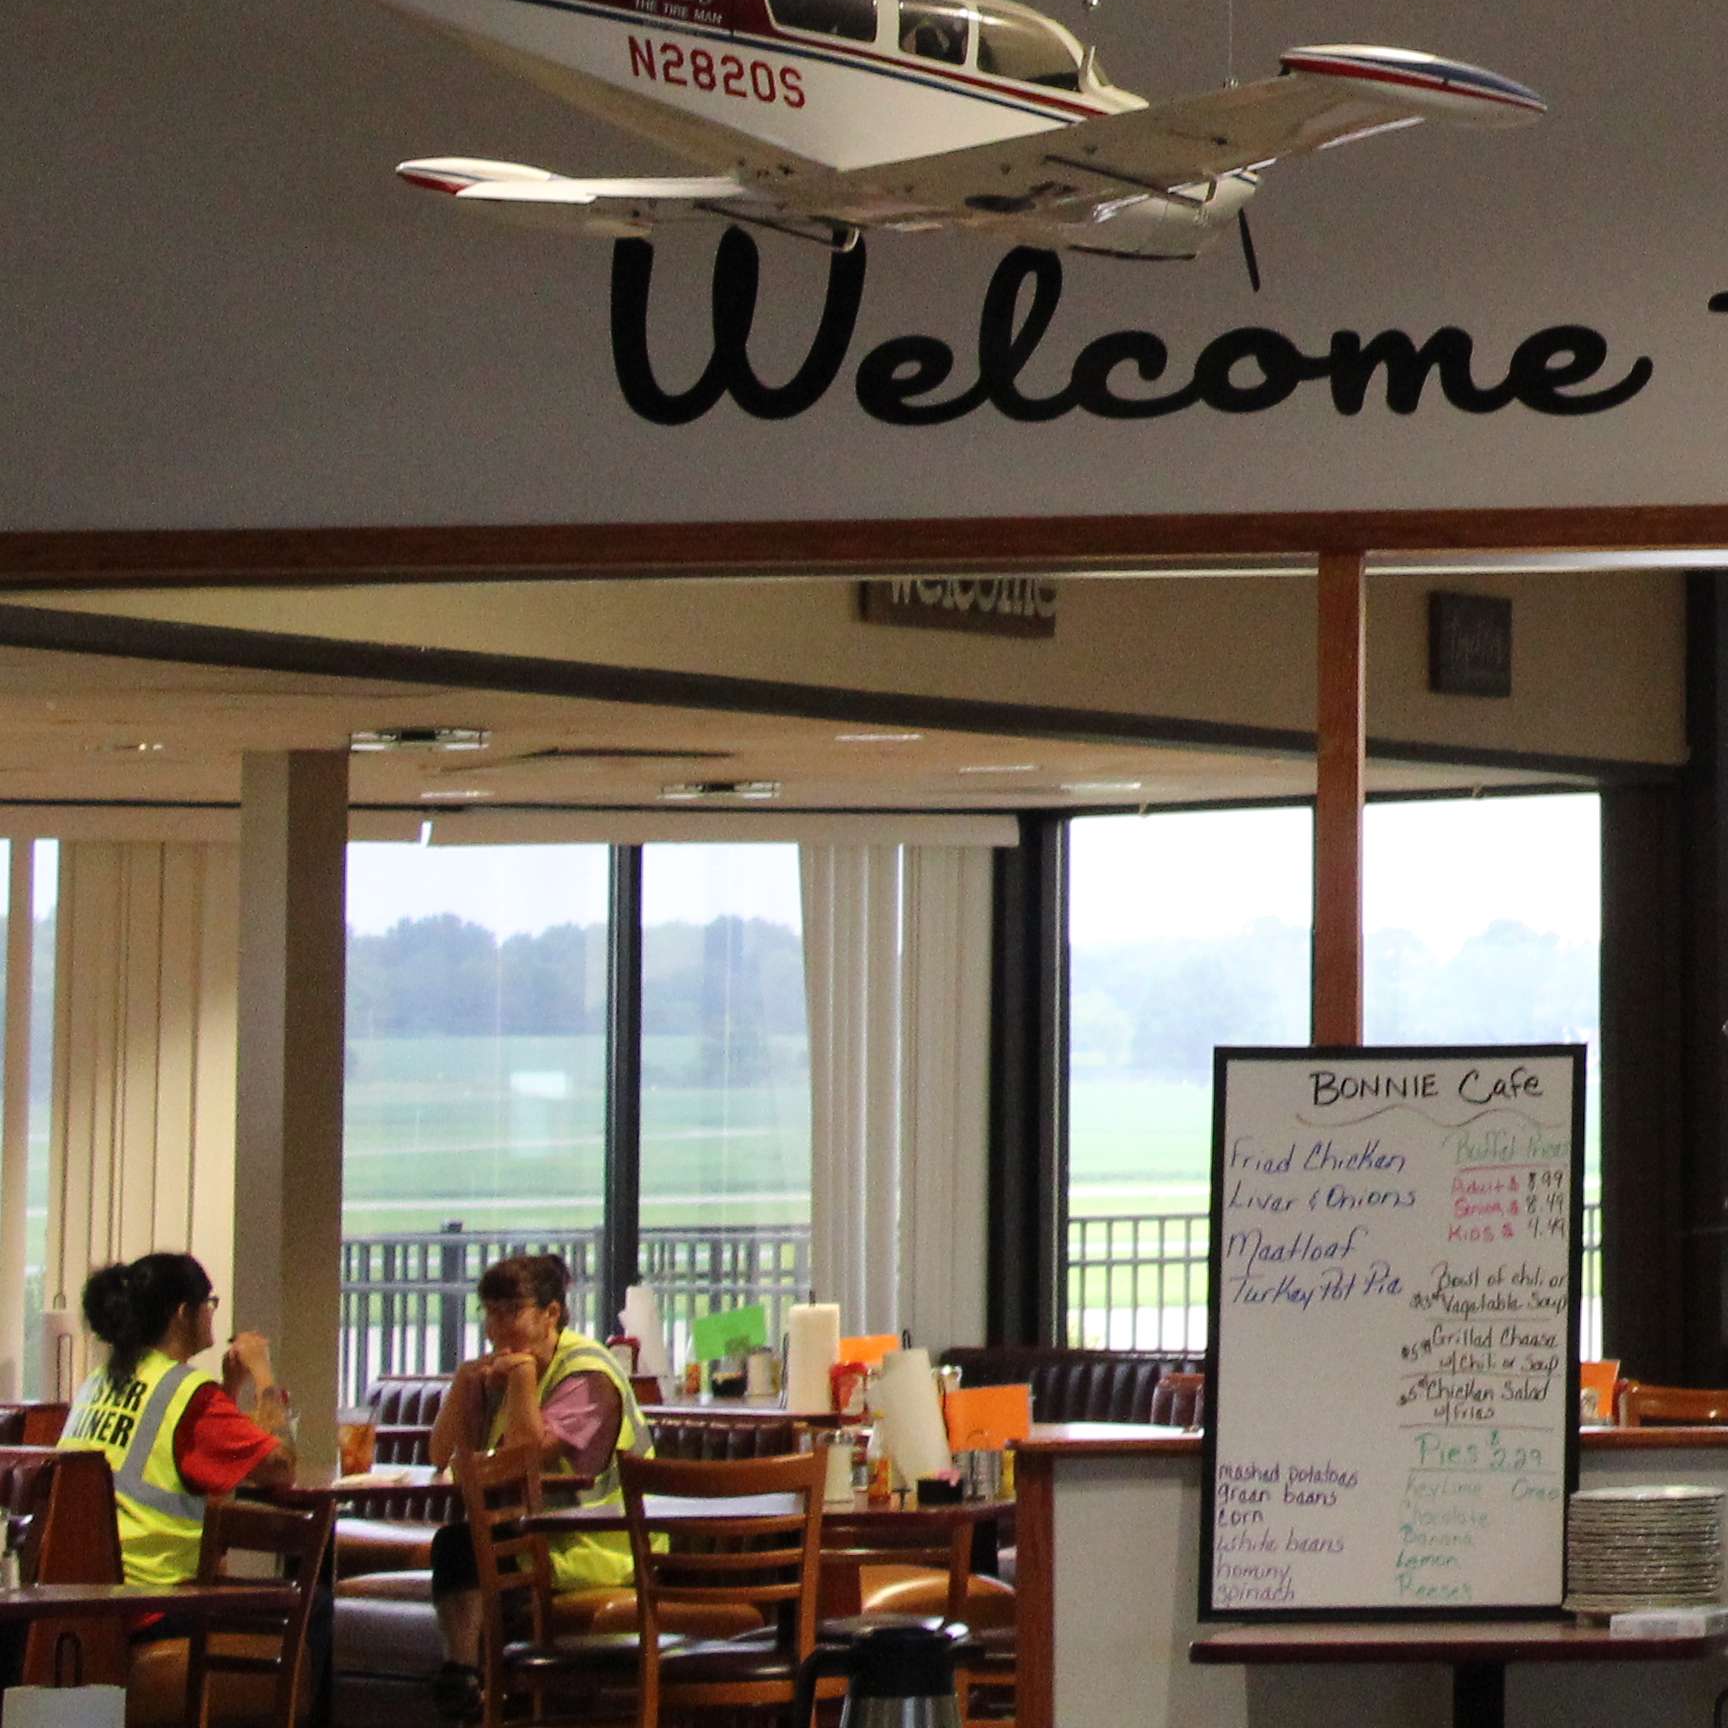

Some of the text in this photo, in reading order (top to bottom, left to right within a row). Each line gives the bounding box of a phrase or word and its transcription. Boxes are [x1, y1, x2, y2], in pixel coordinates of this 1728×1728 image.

[664, 2, 688, 19] TIRE
[694, 8, 722, 24] MAN
[628, 35, 805, 109] N2820S
[610, 225, 1653, 428] Welcome
[1310, 1066, 1544, 1106] BONNIE Cafe
[1326, 1183, 1416, 1210] Onions
